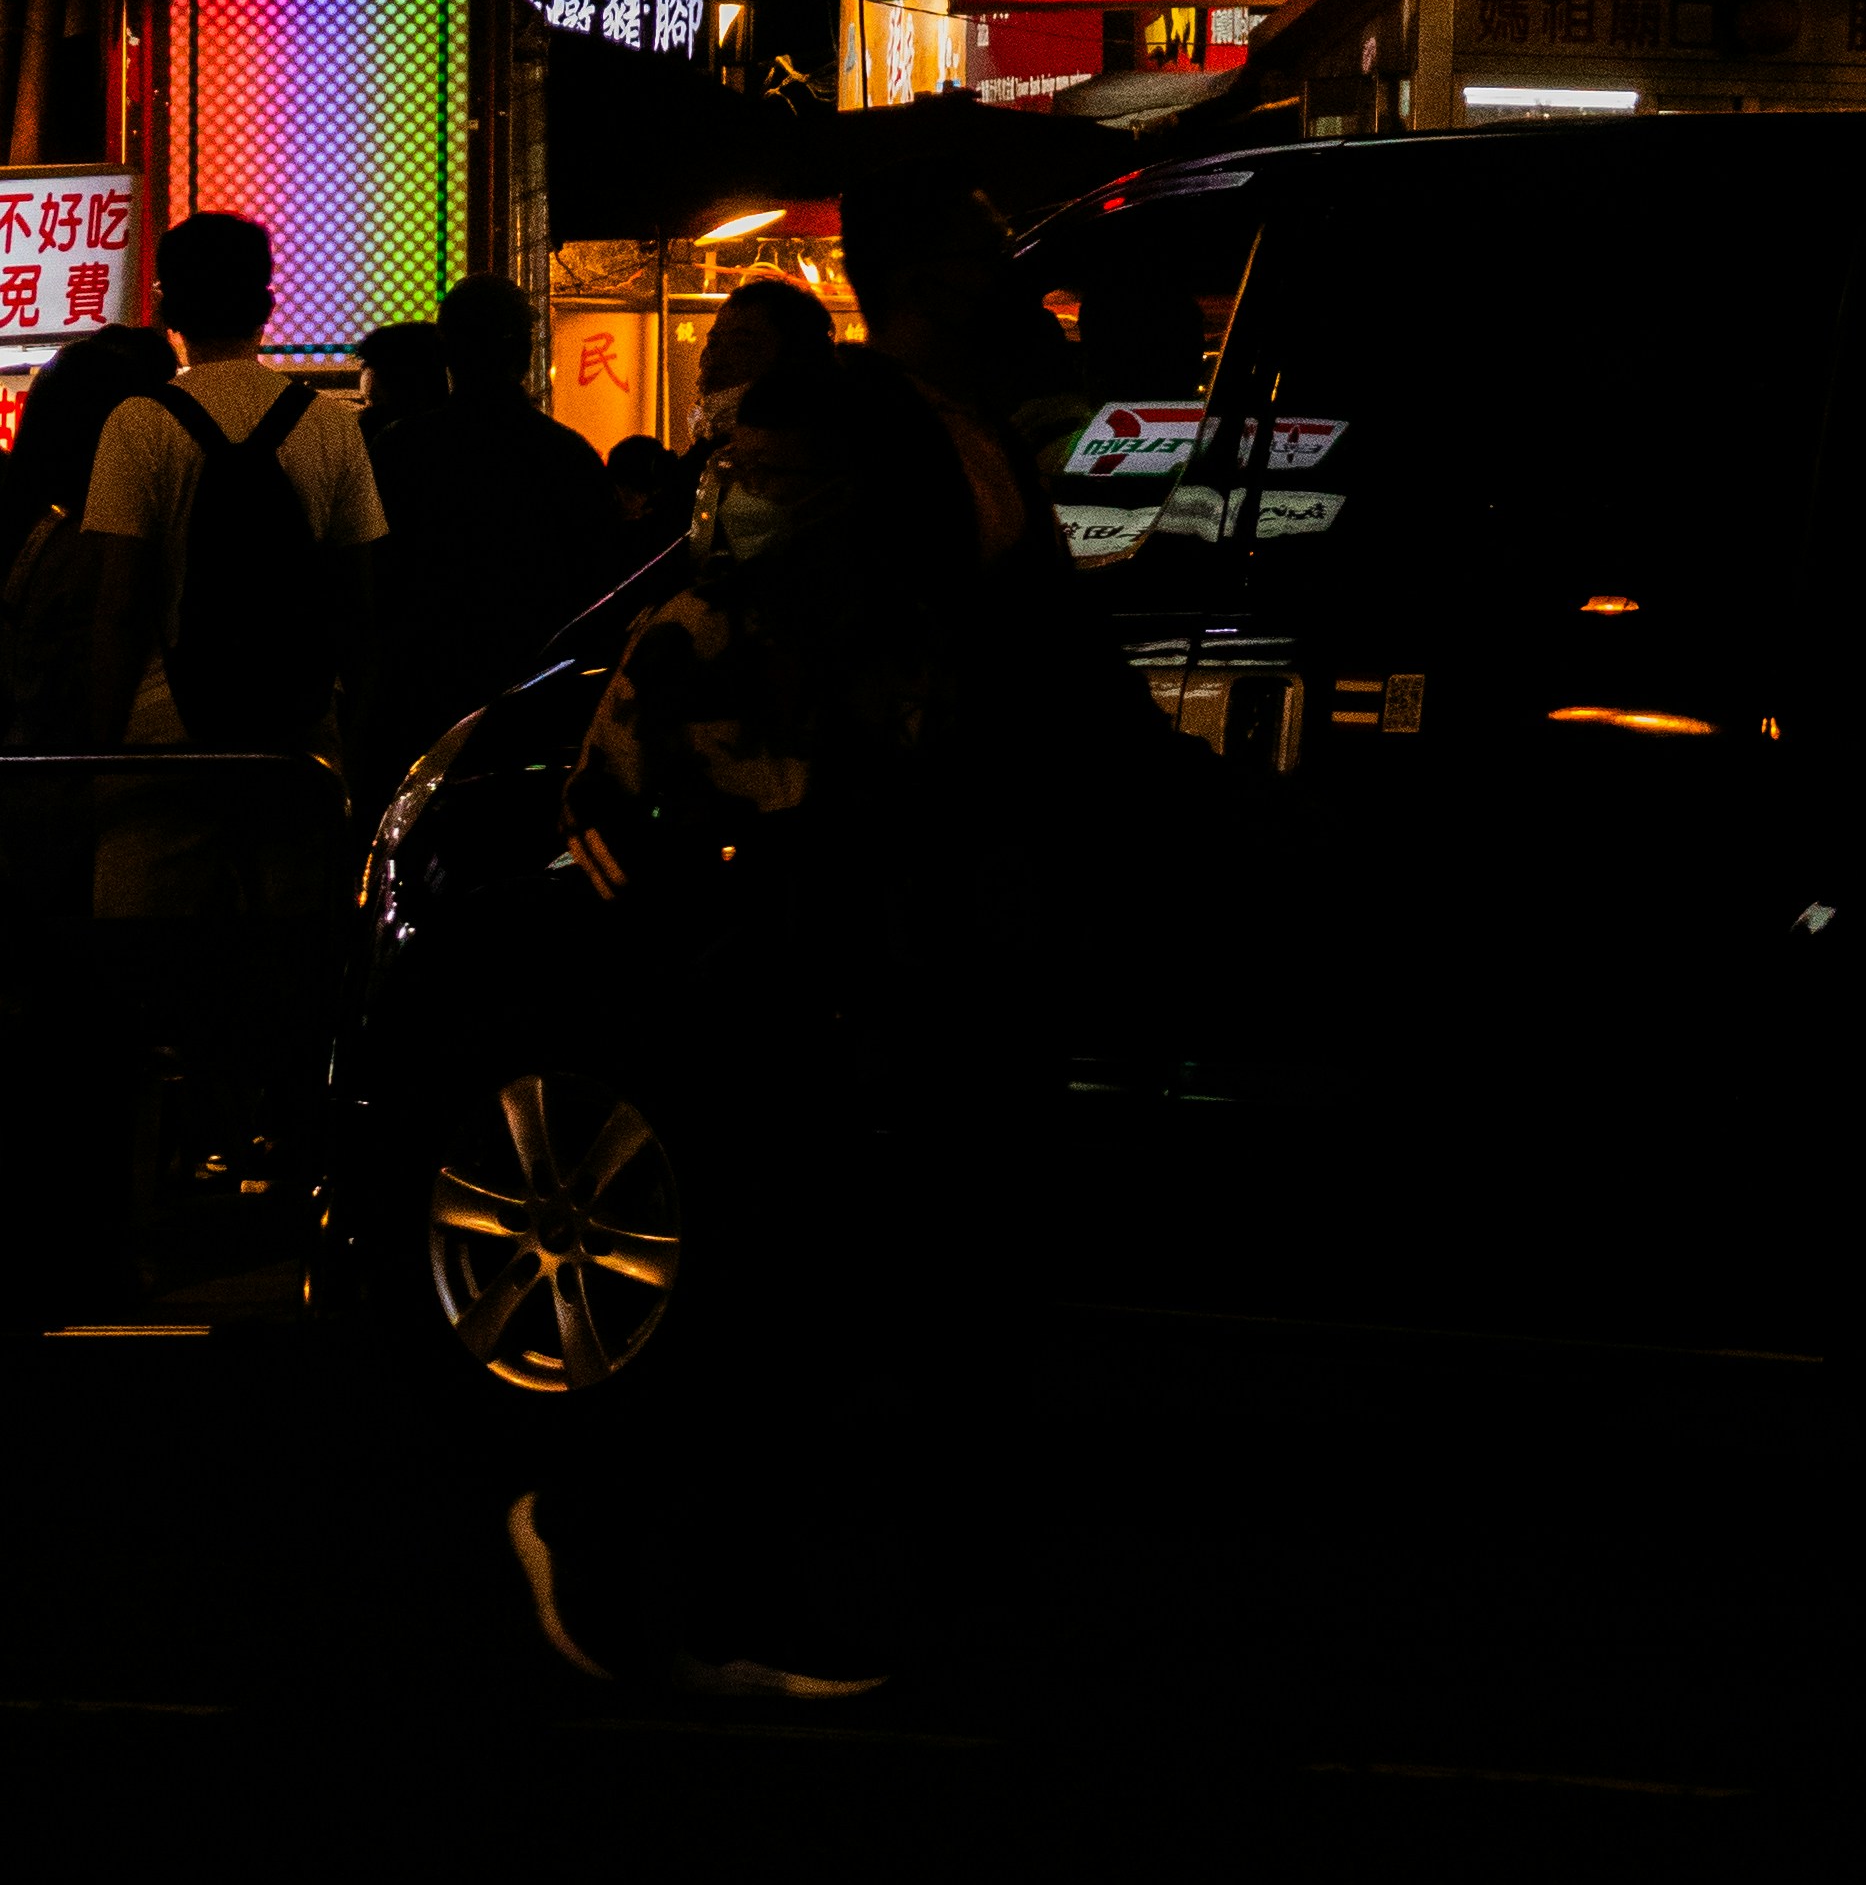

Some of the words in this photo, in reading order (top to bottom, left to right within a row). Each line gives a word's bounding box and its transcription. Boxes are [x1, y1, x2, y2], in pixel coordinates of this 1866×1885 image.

[0, 189, 132, 254] 不好吃
[0, 262, 110, 328] 免費
